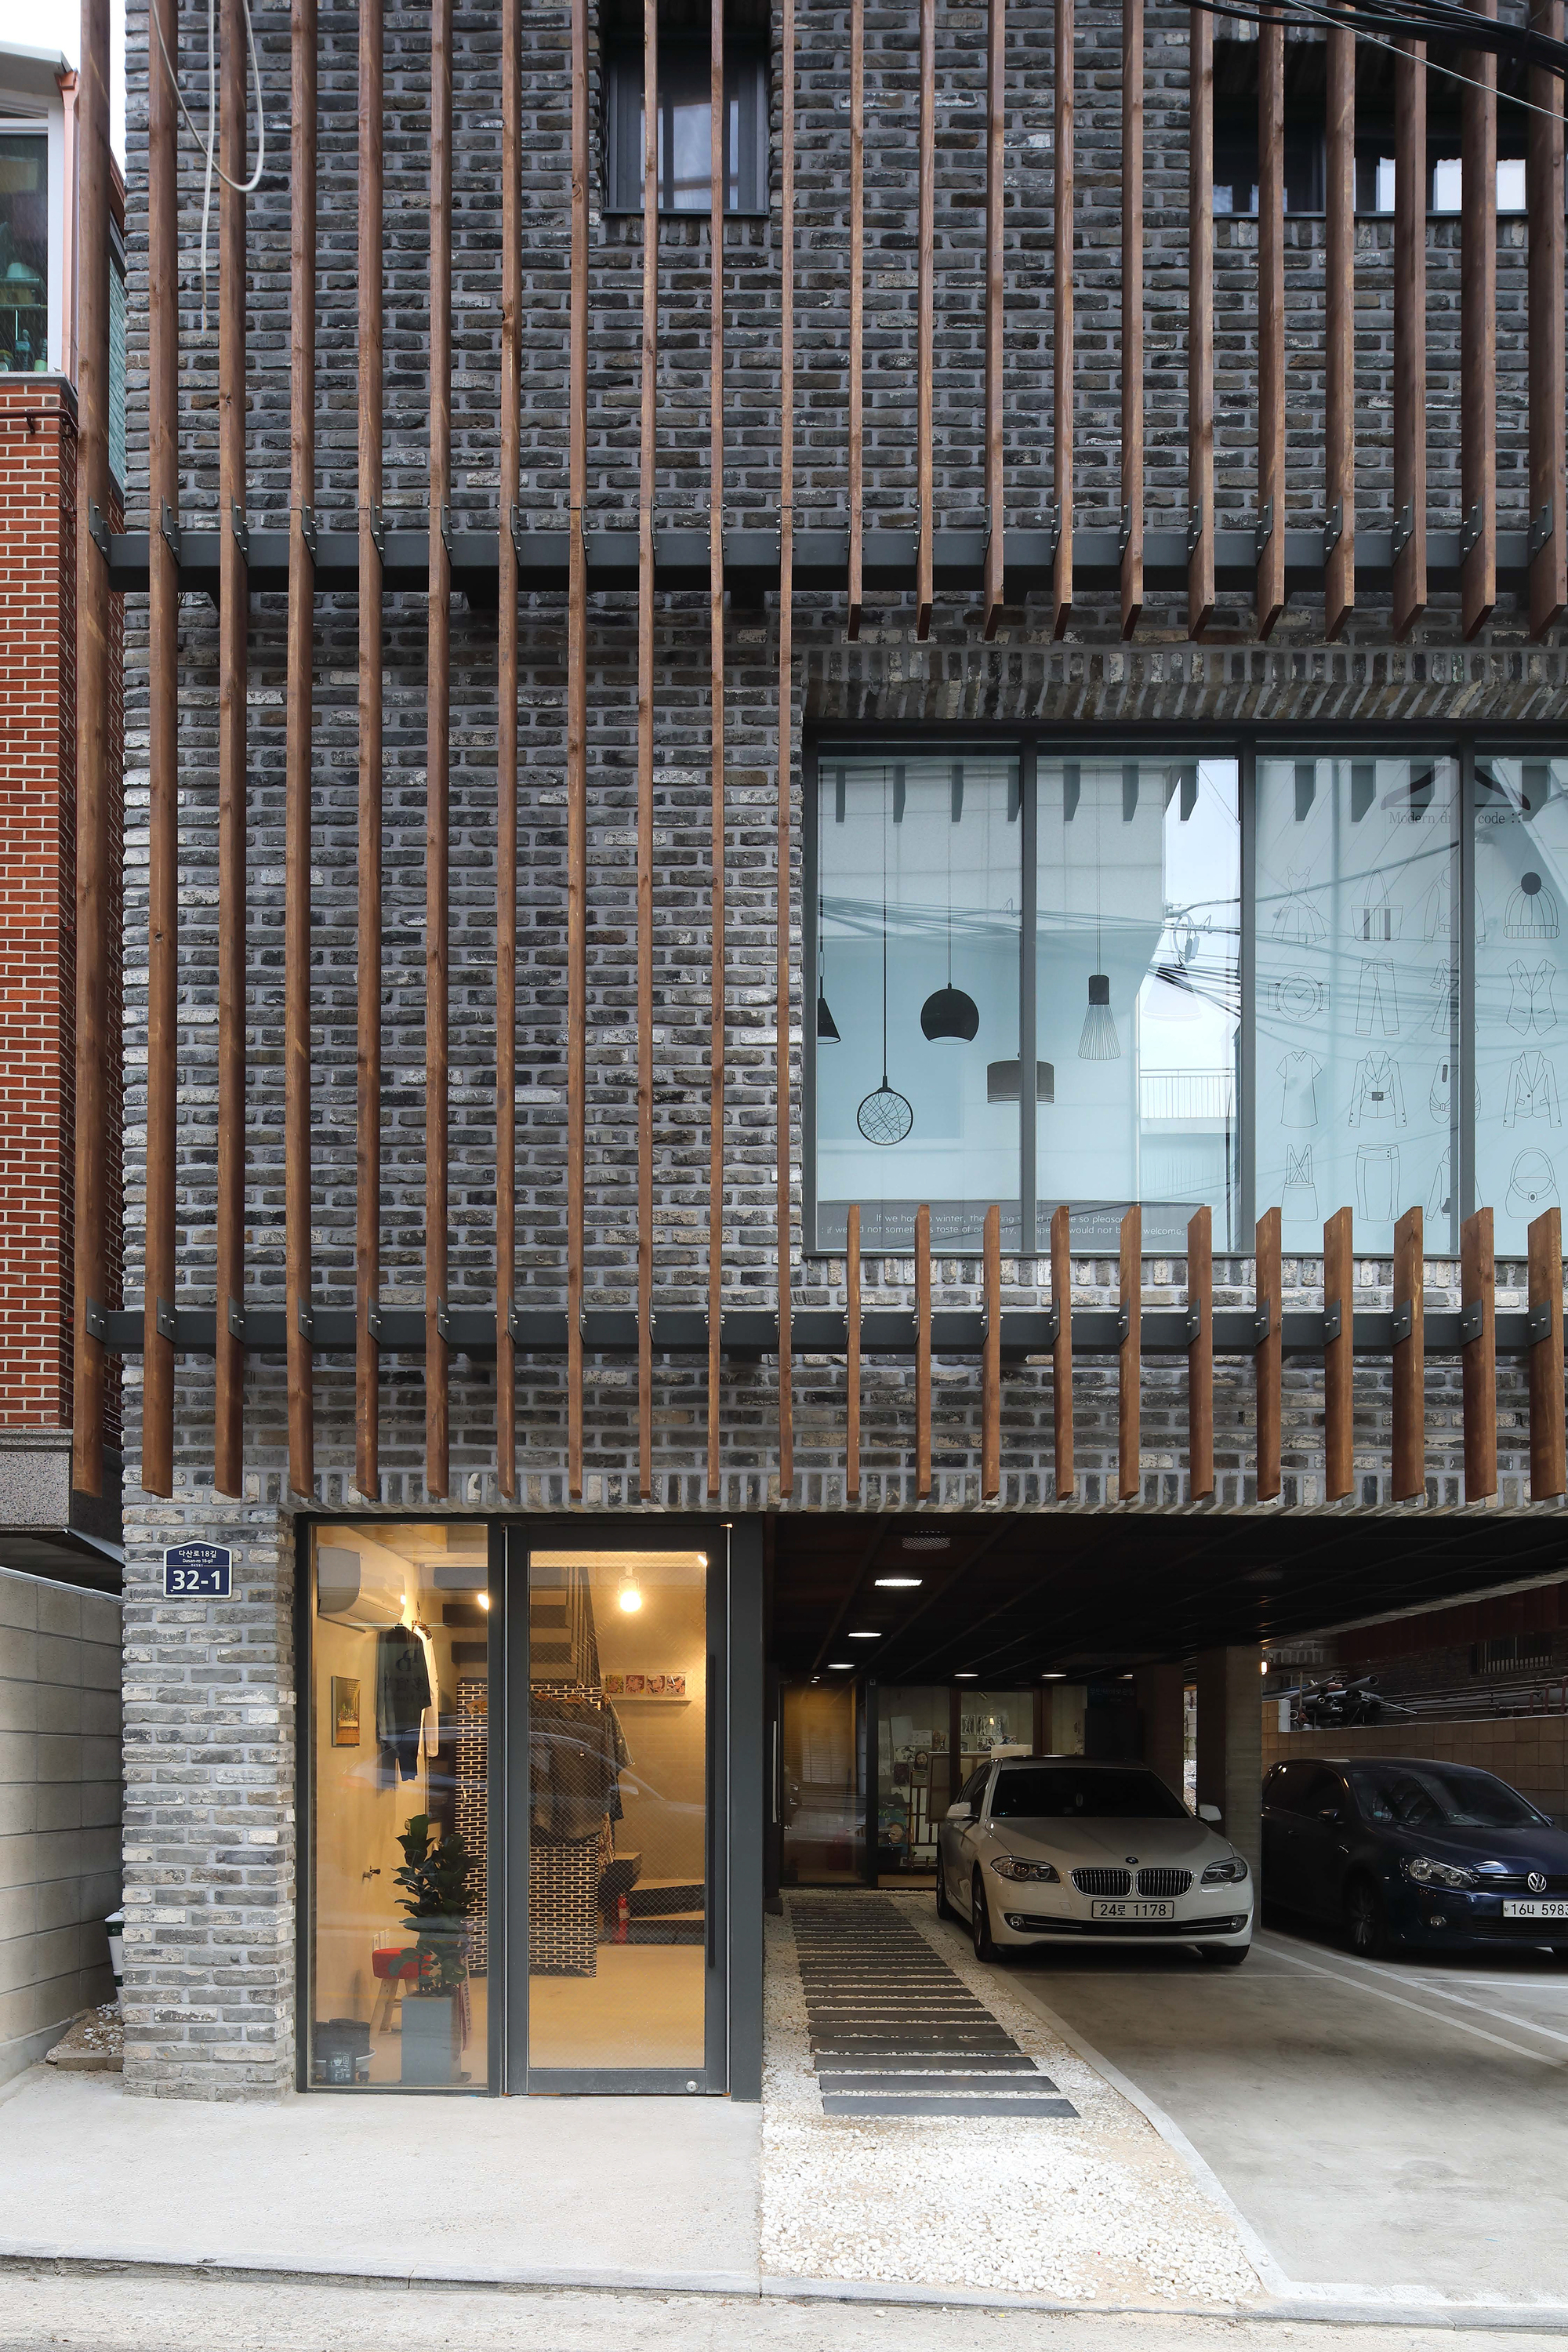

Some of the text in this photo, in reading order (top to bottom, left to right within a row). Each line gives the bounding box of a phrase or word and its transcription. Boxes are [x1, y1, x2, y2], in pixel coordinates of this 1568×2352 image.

[1389, 811, 1435, 824] Modern
[1478, 811, 1505, 824] code
[935, 1214, 966, 1223] winter,
[970, 1214, 985, 1222] the
[1143, 1227, 1185, 1236] welcome.
[172, 1570, 220, 1590] 32-1
[1100, 1904, 1167, 1916] 24로 1178
[1511, 1904, 1535, 1915] 16나
